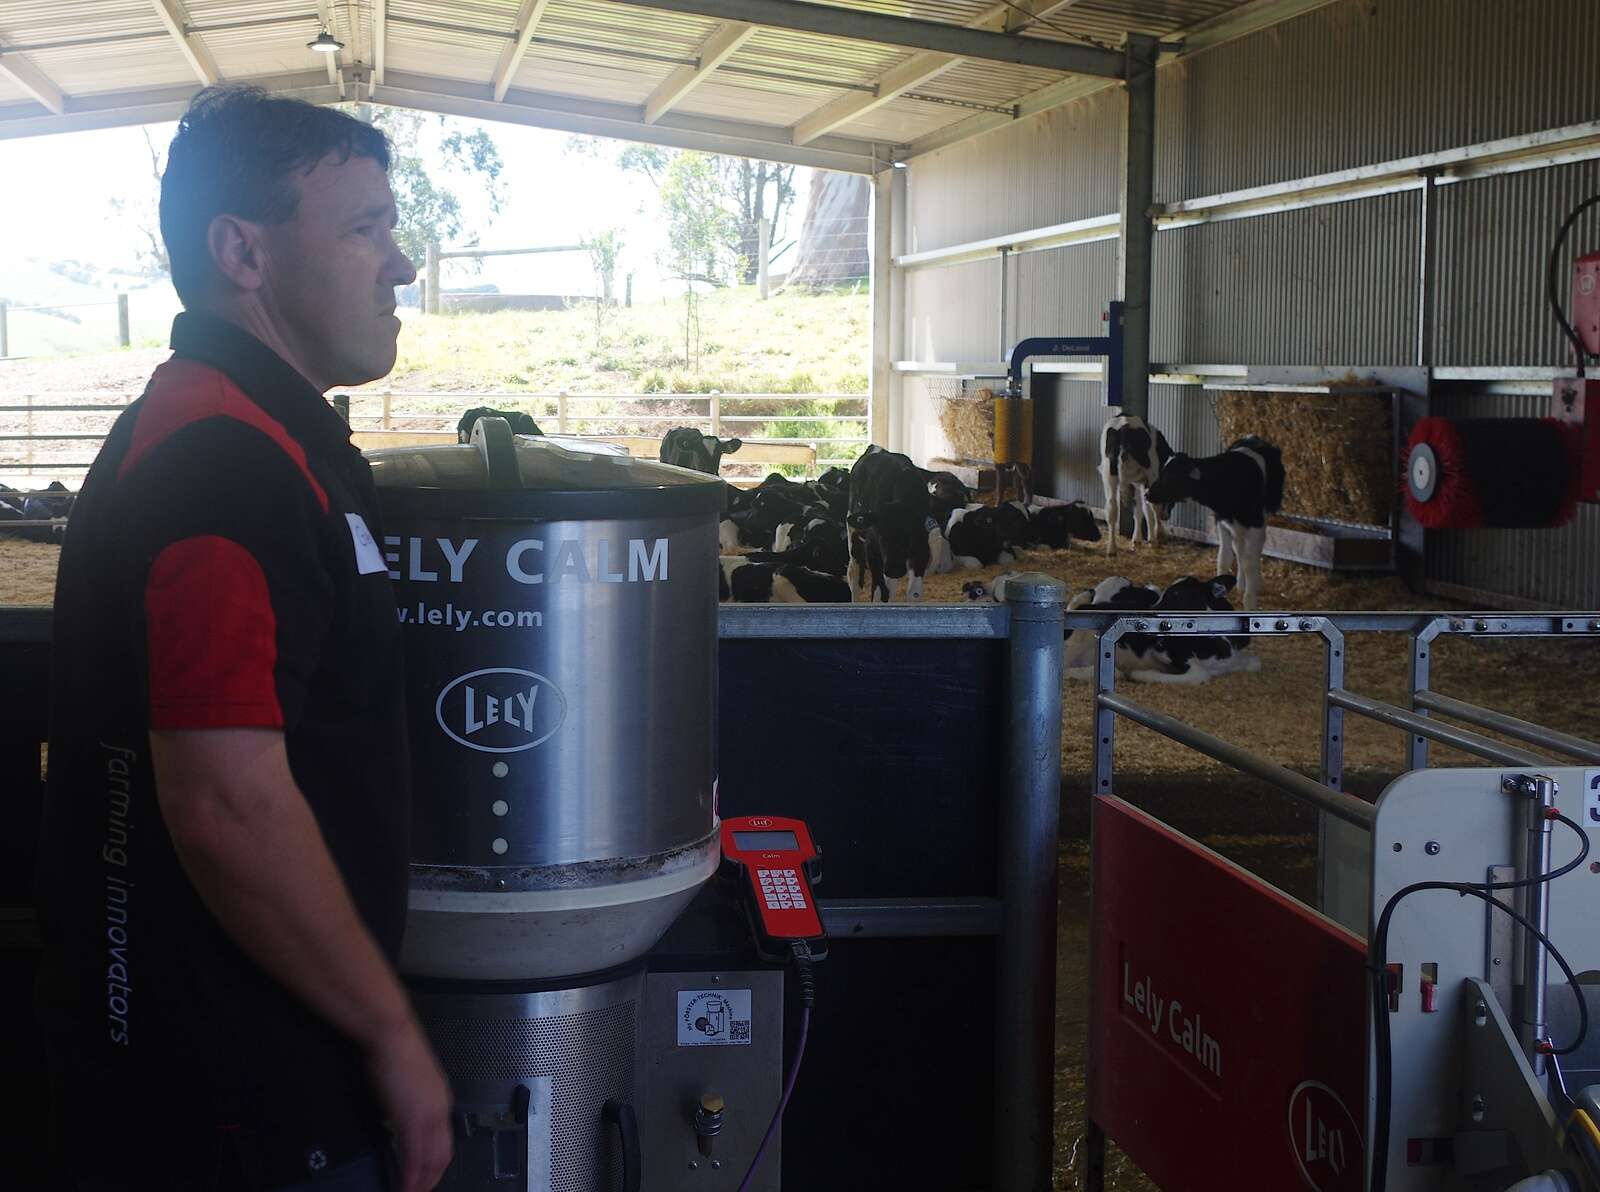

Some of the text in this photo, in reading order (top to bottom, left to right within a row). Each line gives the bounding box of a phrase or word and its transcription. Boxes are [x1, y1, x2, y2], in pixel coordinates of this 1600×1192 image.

[384, 536, 668, 584] ELY CALM
[397, 602, 541, 631] .lely.com
[465, 684, 539, 735] LELY
[99, 740, 136, 1046] farming innovators
[1123, 961, 1223, 1078] Lely Calm
